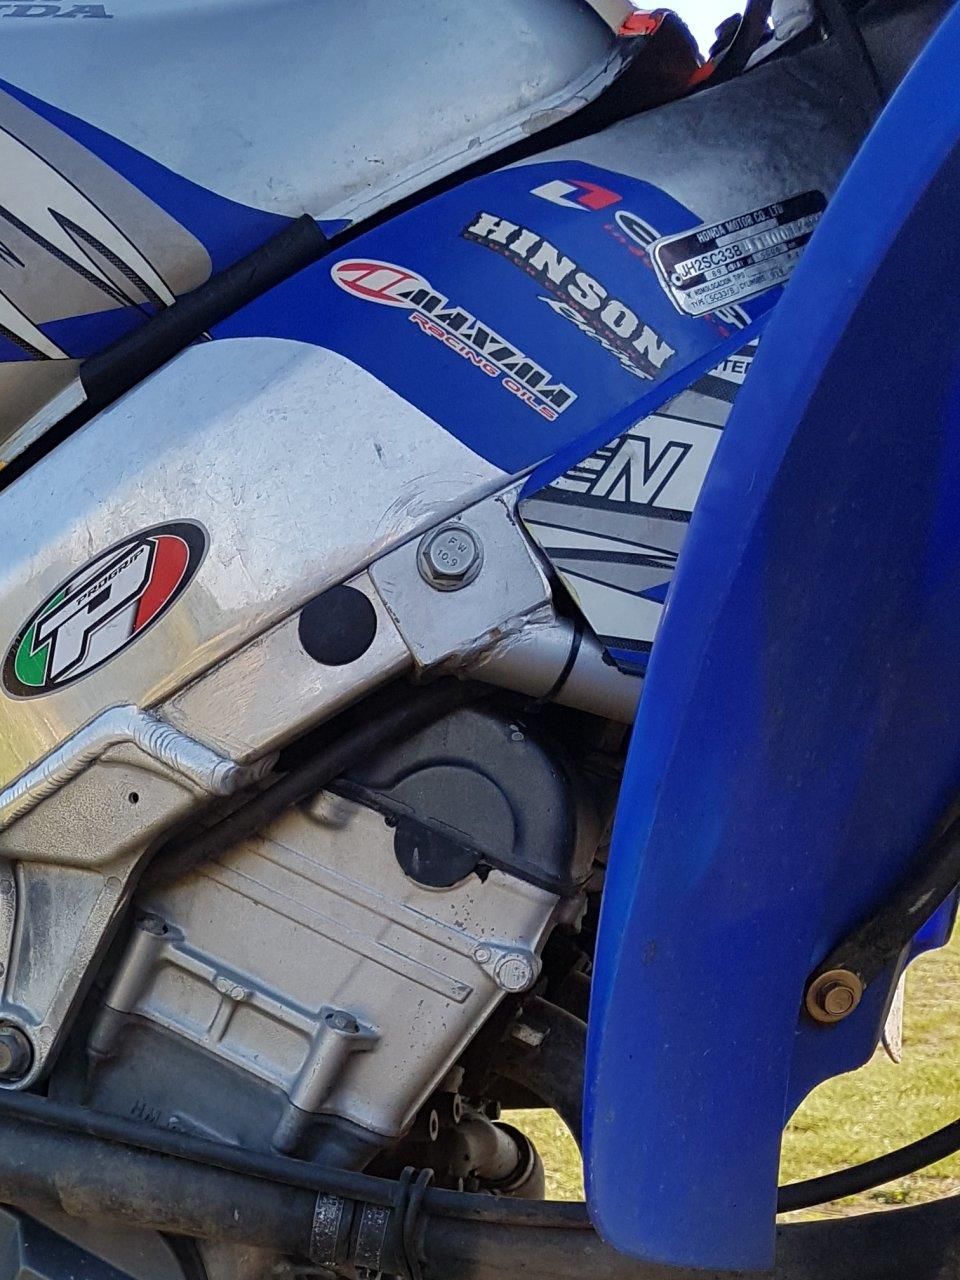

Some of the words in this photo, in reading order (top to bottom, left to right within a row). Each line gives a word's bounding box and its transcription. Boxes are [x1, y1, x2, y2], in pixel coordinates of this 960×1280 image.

[697, 226, 725, 244] HONDA
[726, 217, 753, 233] MOTOR
[467, 212, 676, 369] HINSON
[502, 377, 560, 421] OILS
[75, 547, 145, 605] PROGRIP
[437, 549, 458, 567] 10.9
